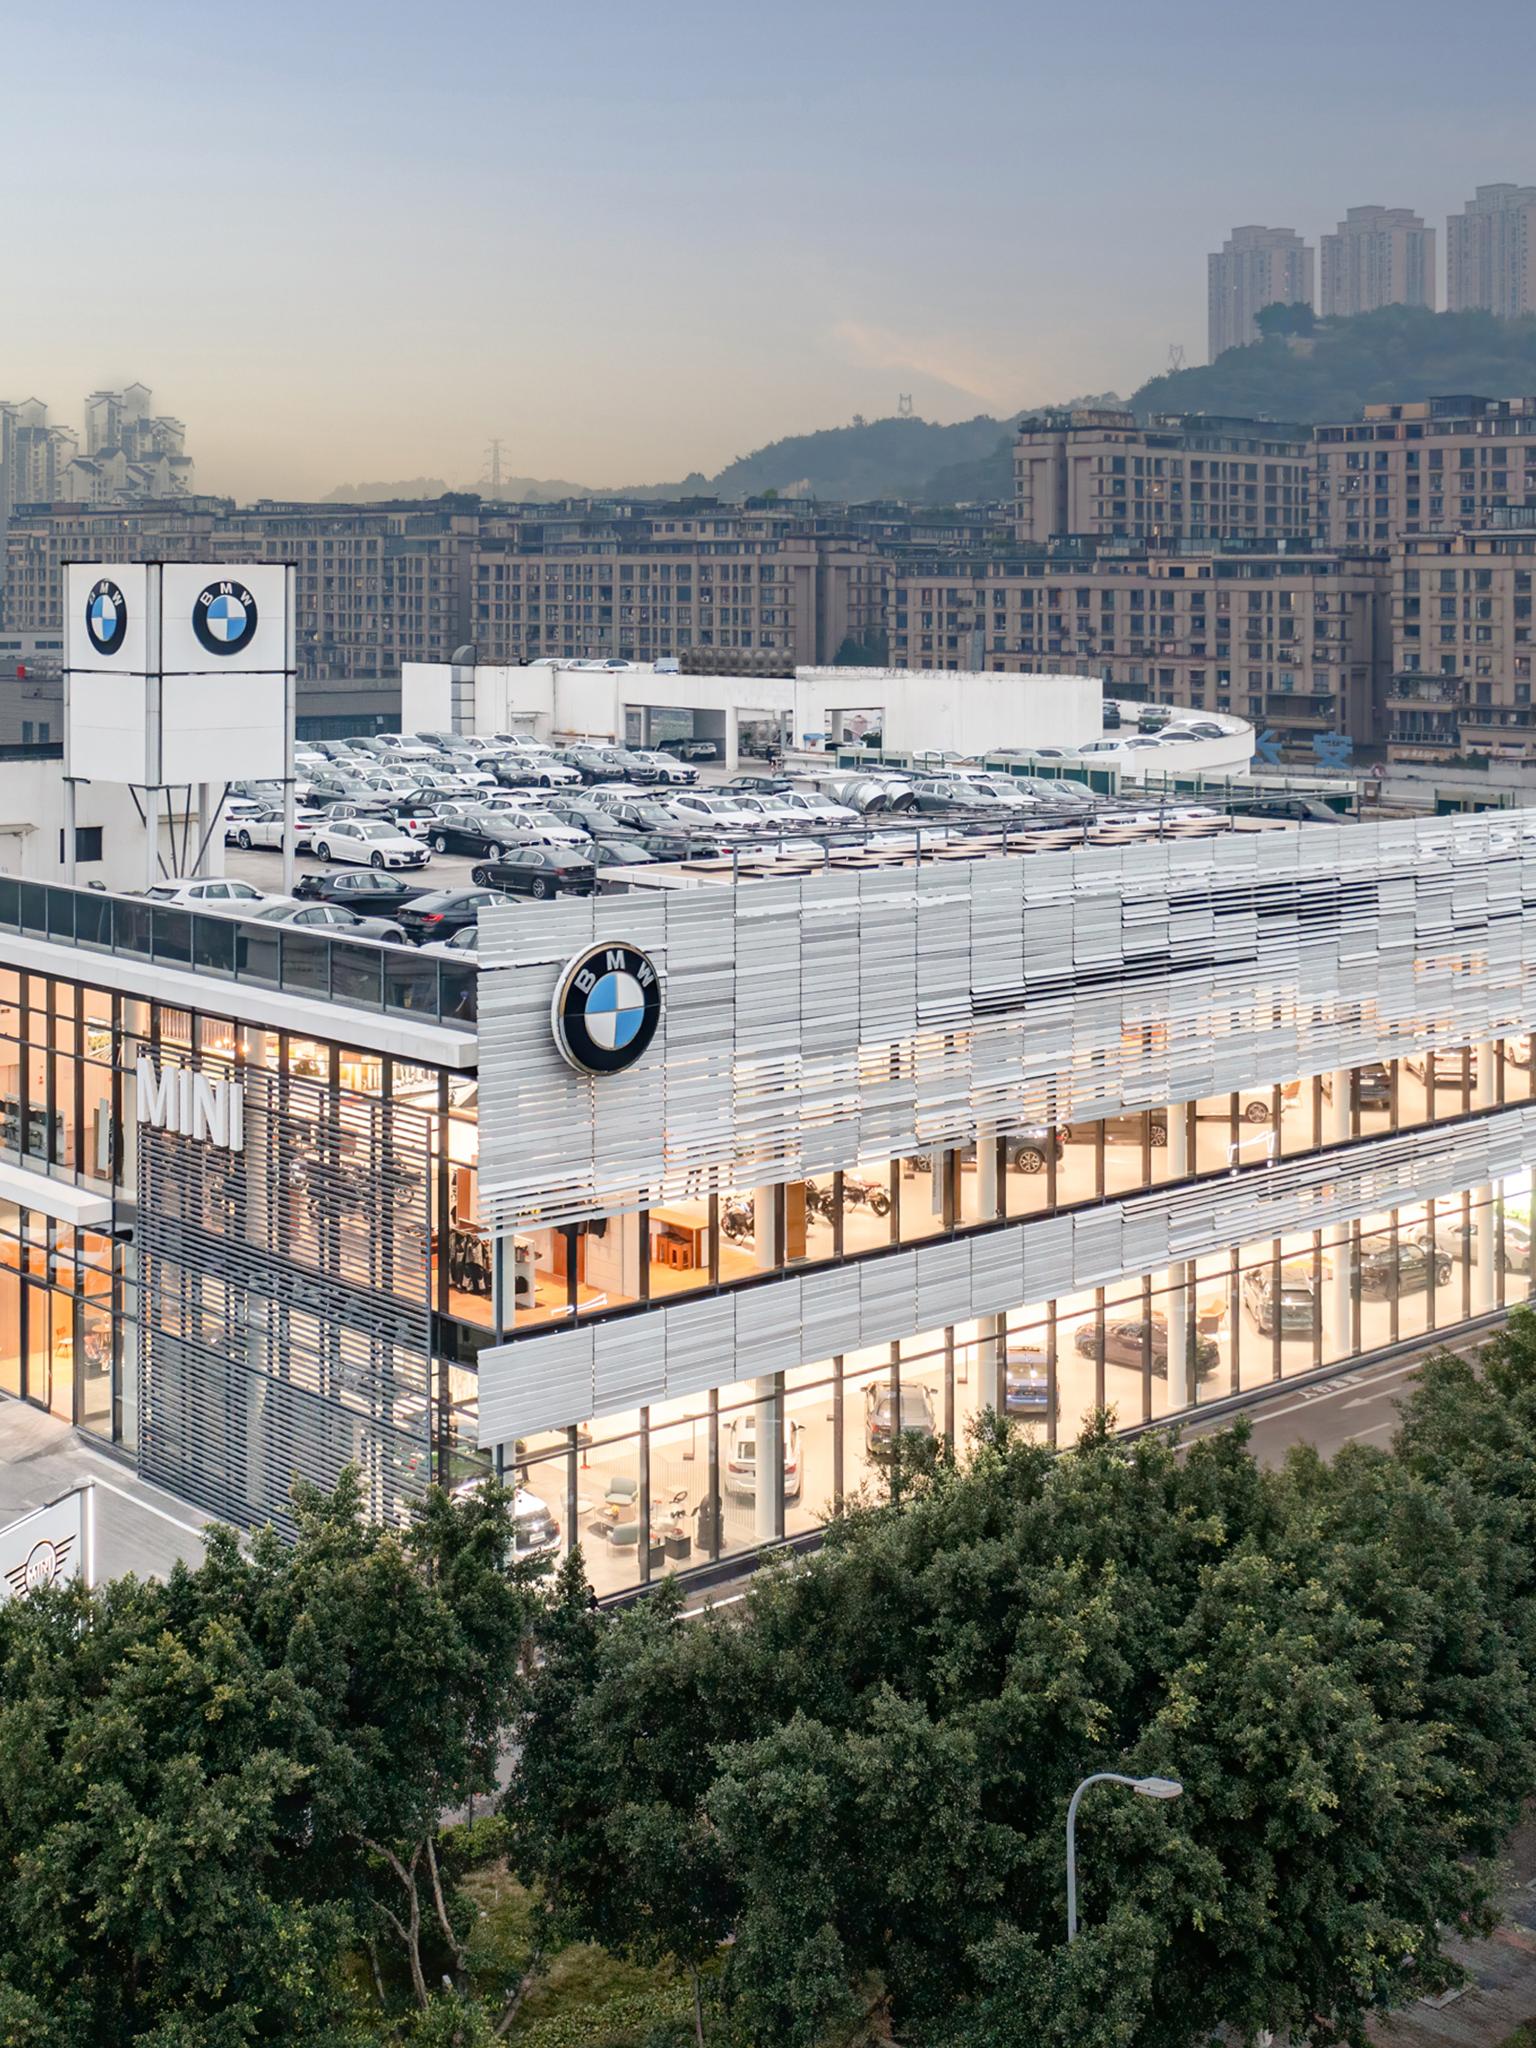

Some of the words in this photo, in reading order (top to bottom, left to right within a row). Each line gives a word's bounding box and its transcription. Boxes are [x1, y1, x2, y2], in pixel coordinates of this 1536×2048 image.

[89, 582, 123, 606] BMW
[200, 582, 252, 607] BMW
[573, 949, 655, 995] BMW
[137, 1057, 243, 1151] MINI
